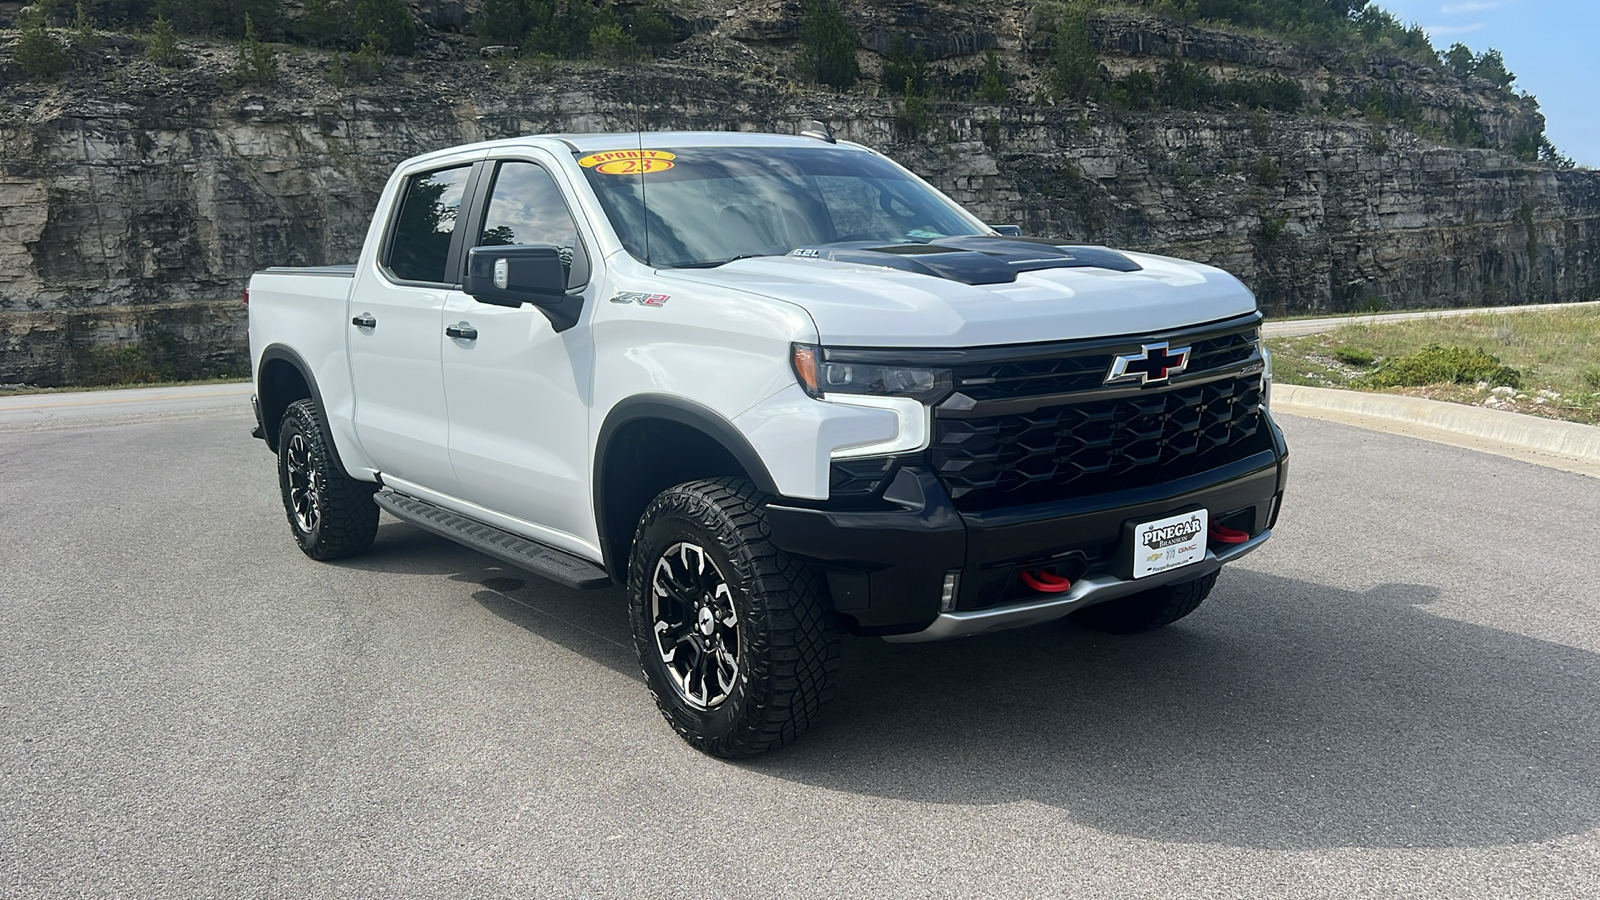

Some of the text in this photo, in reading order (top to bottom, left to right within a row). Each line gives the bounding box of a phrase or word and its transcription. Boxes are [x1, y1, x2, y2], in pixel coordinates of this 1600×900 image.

[592, 151, 658, 162] SPORTY
[621, 159, 652, 174] 23
[610, 291, 671, 307] ZR2
[1143, 520, 1201, 545] PINEGAR
[1178, 544, 1197, 553] GMC
